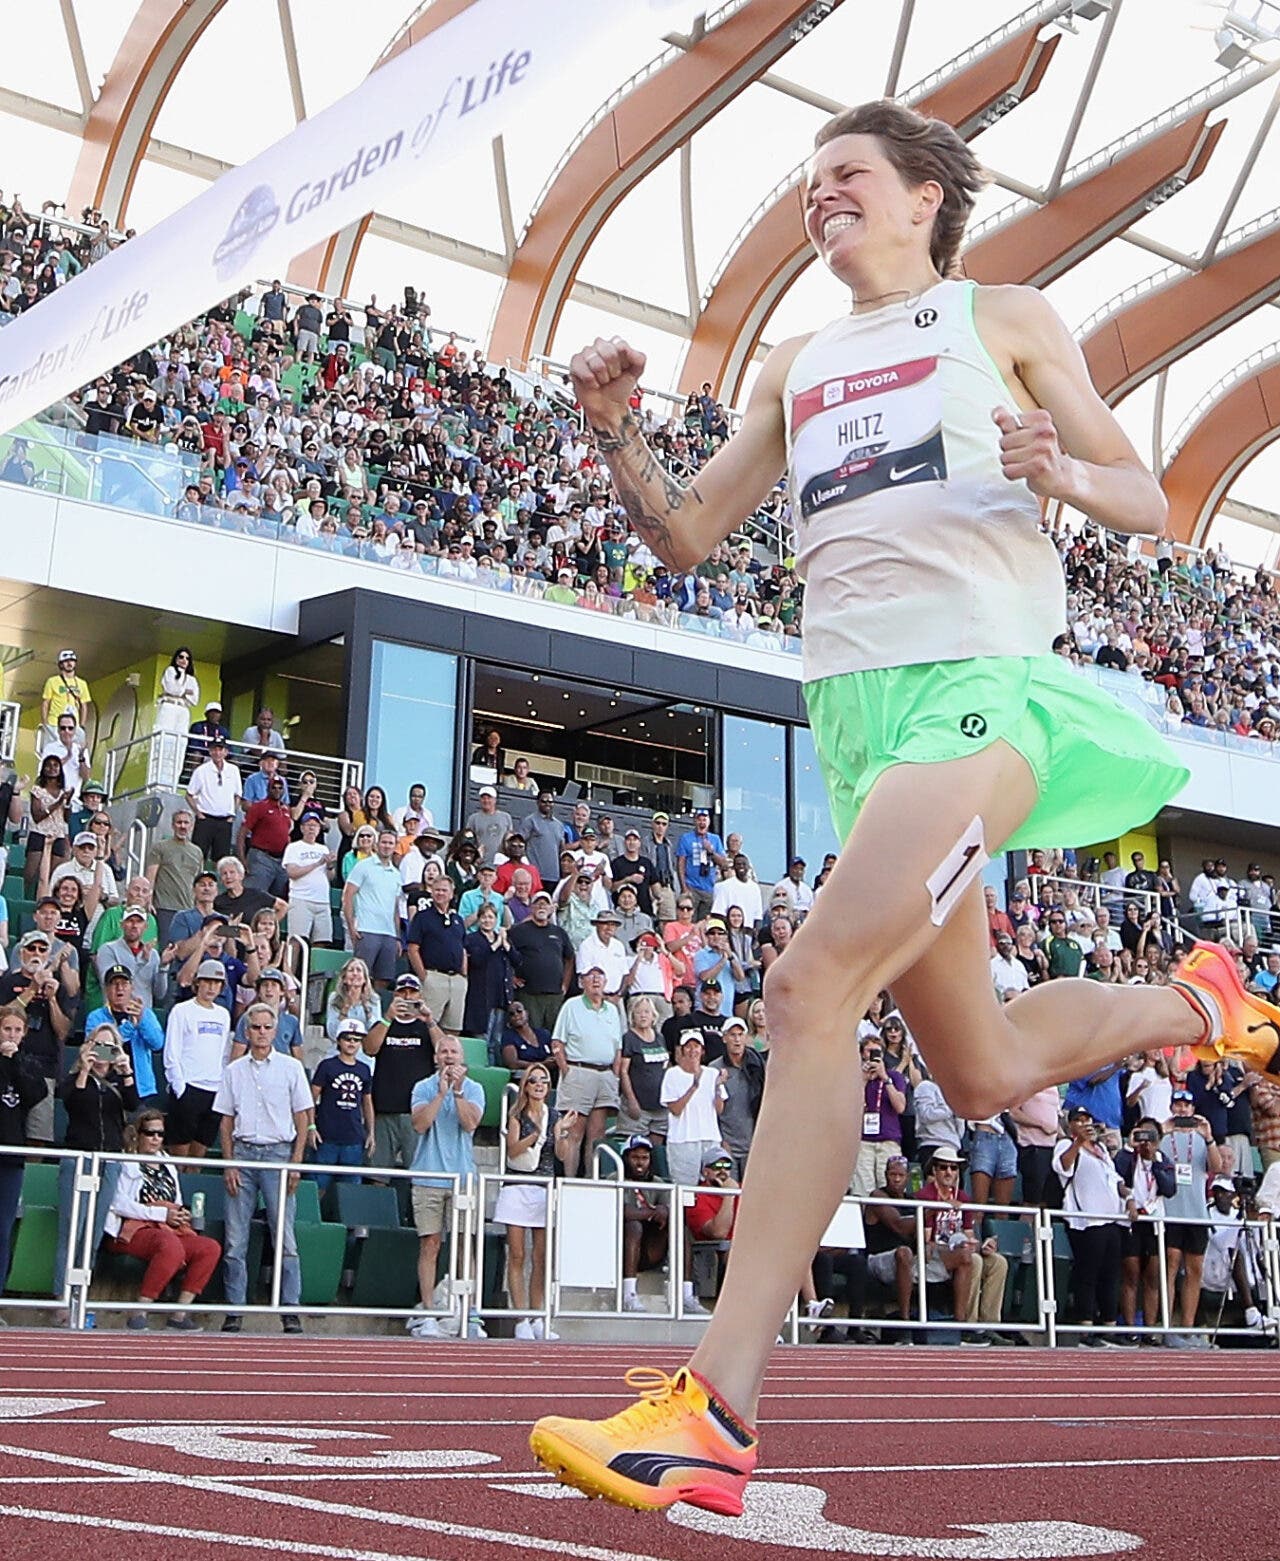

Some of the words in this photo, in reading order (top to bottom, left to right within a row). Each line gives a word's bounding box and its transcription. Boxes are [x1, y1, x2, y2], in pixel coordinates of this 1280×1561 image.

[285, 131, 404, 224] Garden
[411, 77, 462, 159] of
[458, 50, 532, 118] Life
[70, 305, 107, 371] of
[101, 290, 149, 342] Life
[847, 371, 899, 393] TOYOTA
[838, 413, 883, 446] HILTZ
[936, 843, 980, 904] 1
